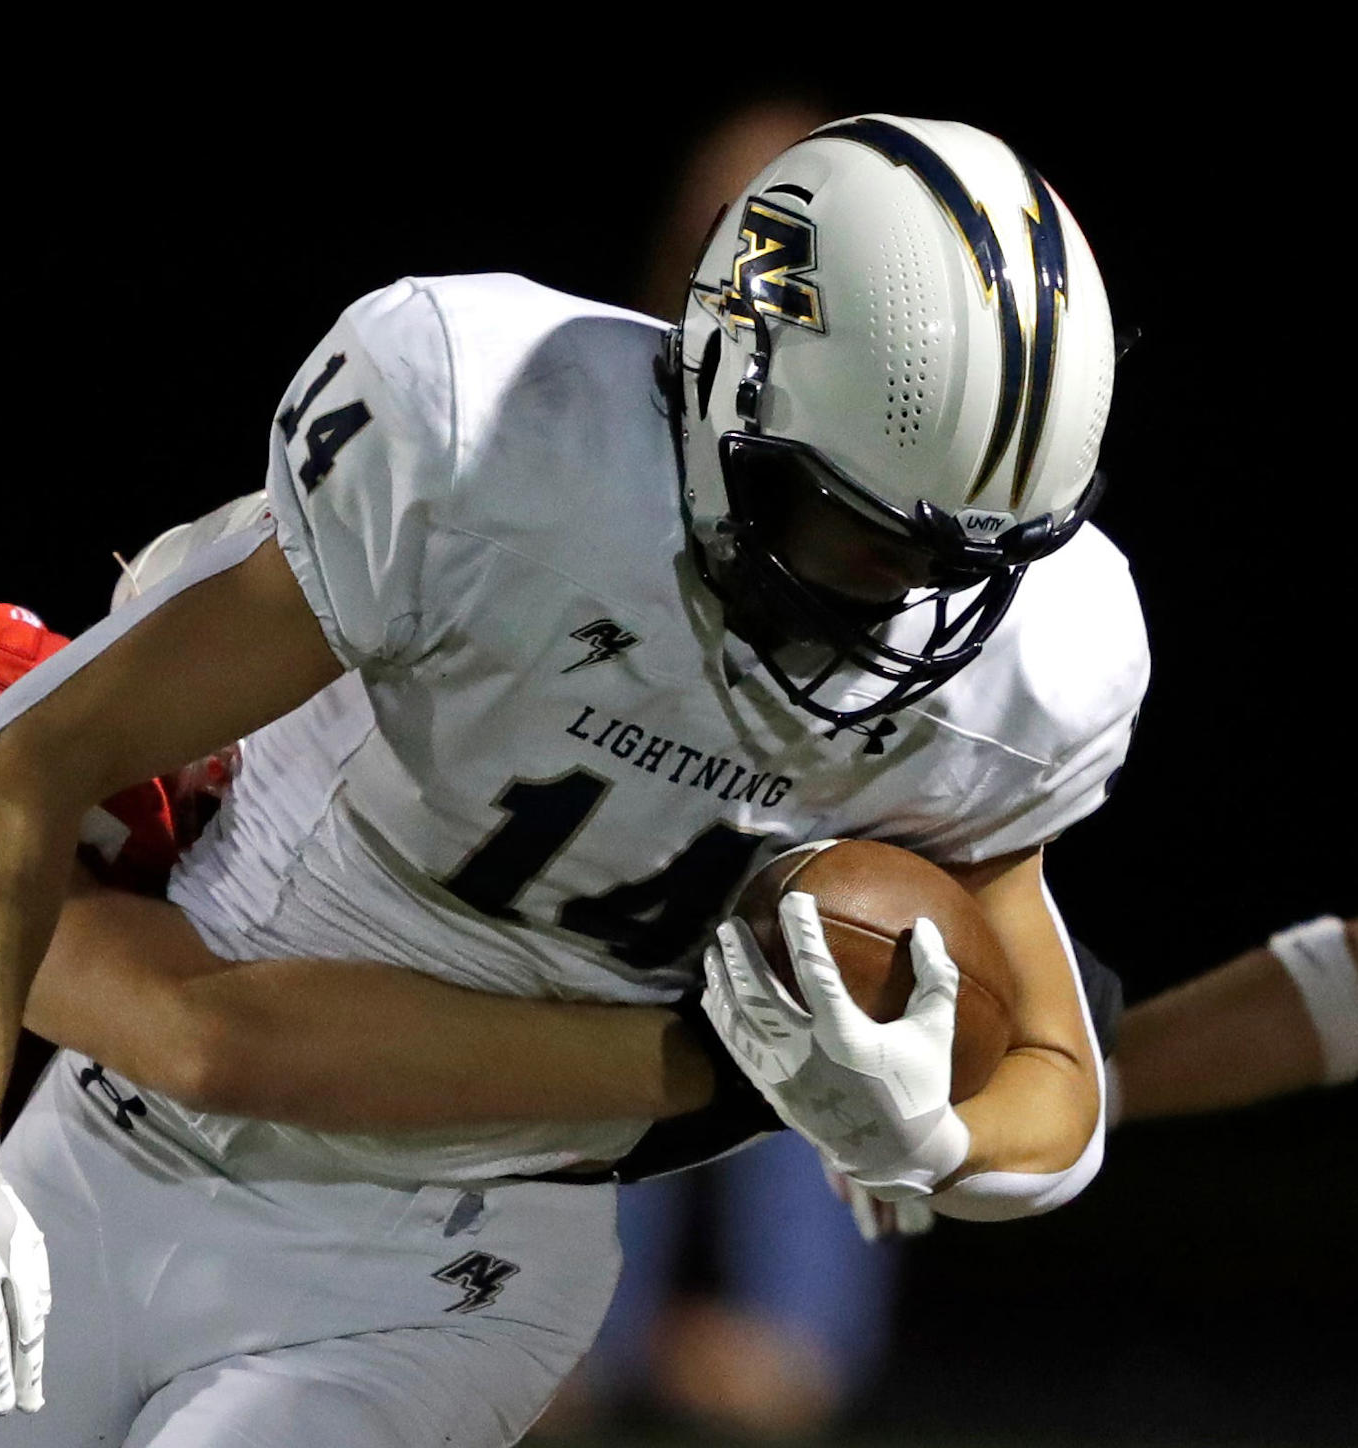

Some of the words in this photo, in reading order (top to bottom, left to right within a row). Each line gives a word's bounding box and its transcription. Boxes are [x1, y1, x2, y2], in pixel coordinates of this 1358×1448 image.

[278, 351, 374, 495] 14
[565, 705, 793, 808] LIGHTNING
[438, 763, 774, 969] 14
